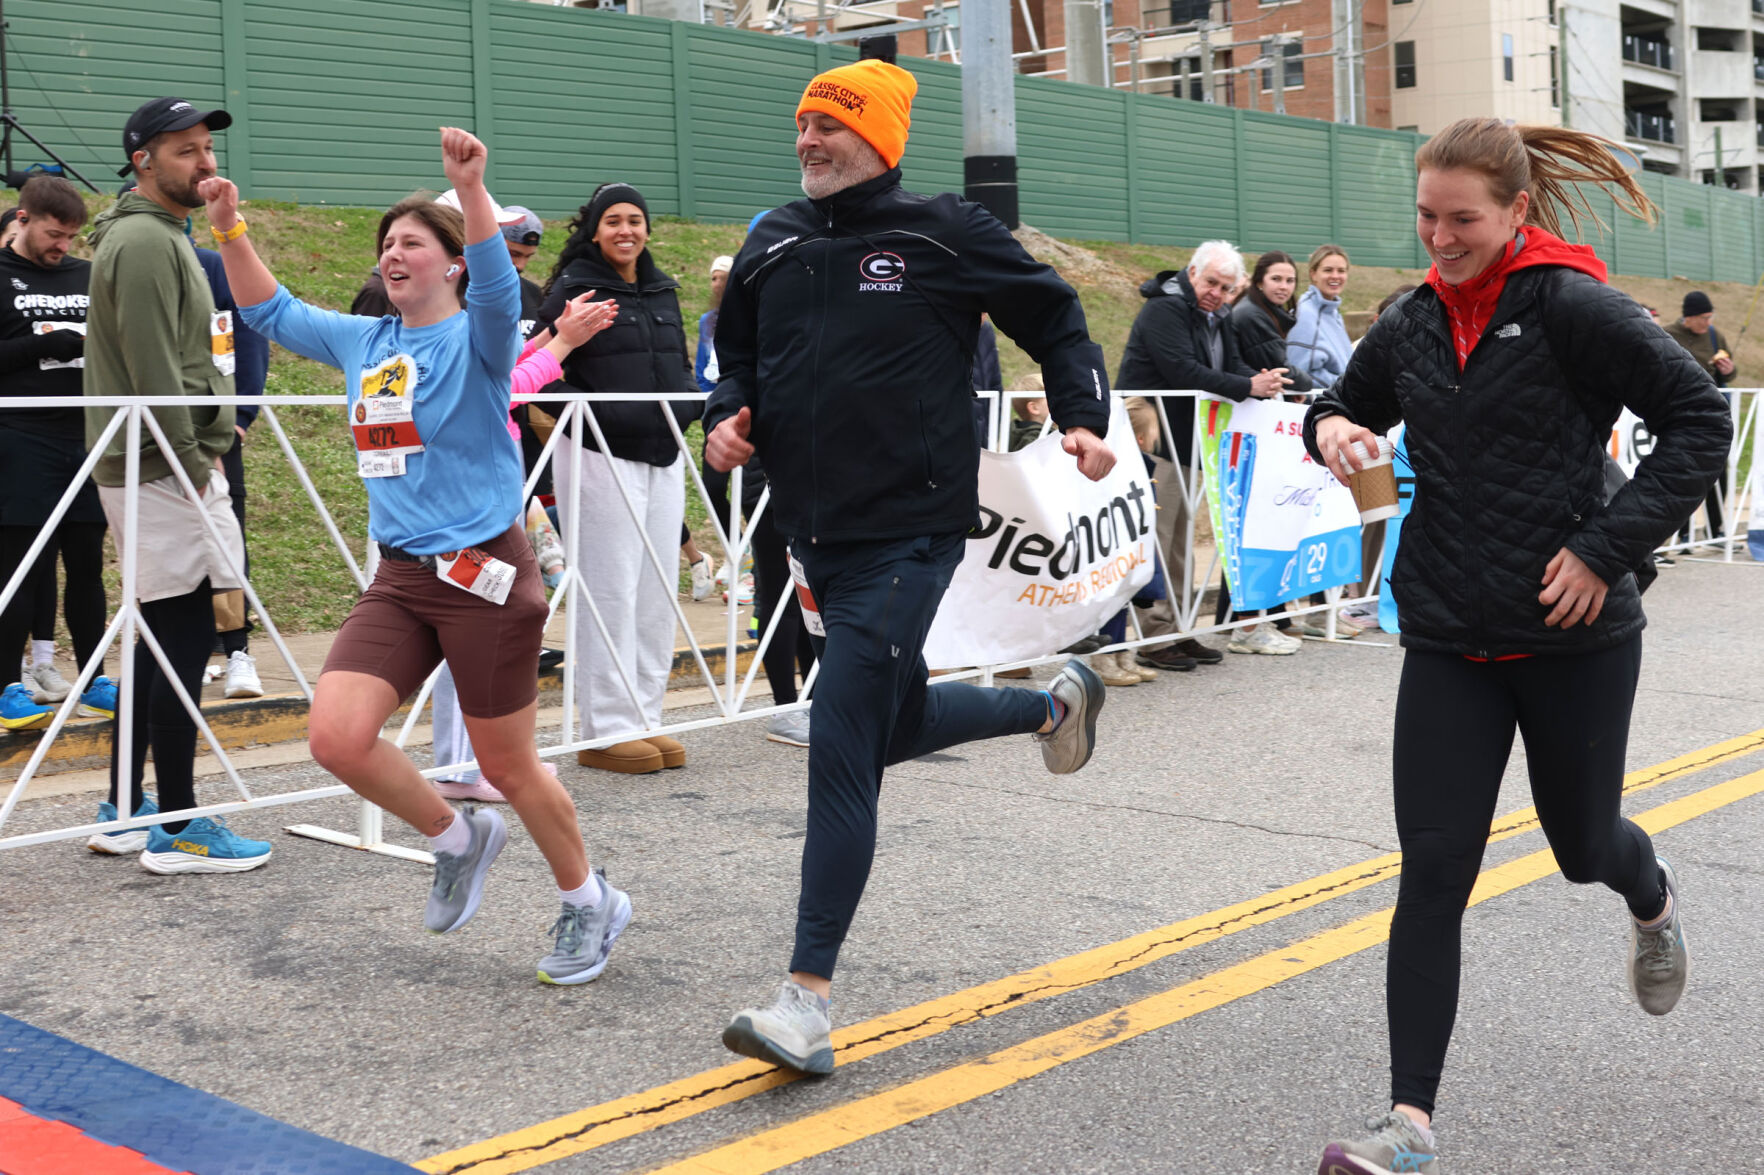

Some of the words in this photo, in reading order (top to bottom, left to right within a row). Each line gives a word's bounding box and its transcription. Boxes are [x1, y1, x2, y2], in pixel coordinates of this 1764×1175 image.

[811, 82, 840, 93] CLASSIC
[807, 89, 855, 111] MARATHON
[859, 283, 903, 291] HOCKEY
[14, 293, 90, 310] CHEROKE
[368, 426, 399, 447] 4272
[1274, 420, 1285, 435] A
[1288, 422, 1303, 438] SU
[1307, 542, 1327, 574] 29
[171, 838, 208, 857] HOKA
